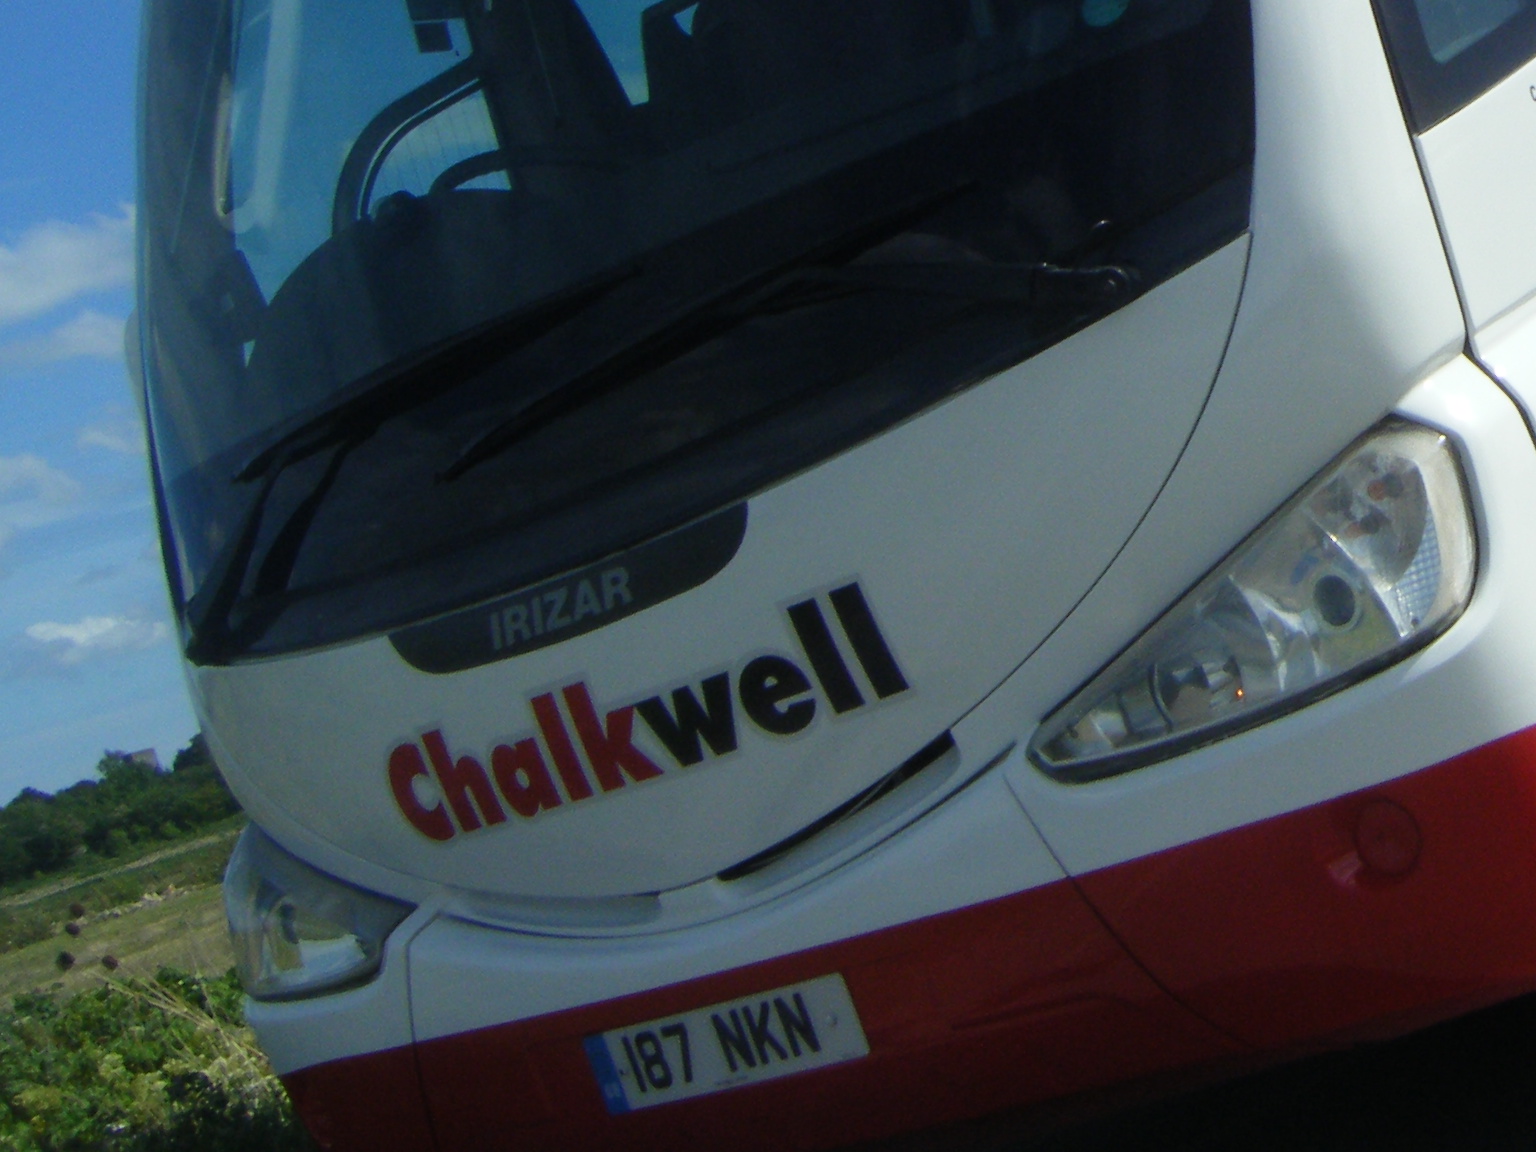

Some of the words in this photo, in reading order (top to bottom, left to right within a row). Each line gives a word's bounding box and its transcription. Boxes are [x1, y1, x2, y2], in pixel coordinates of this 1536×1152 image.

[489, 566, 633, 650] IRIZAR
[387, 581, 910, 841] Chalkwell
[620, 1022, 694, 1093] 187
[710, 992, 822, 1073] NKN
